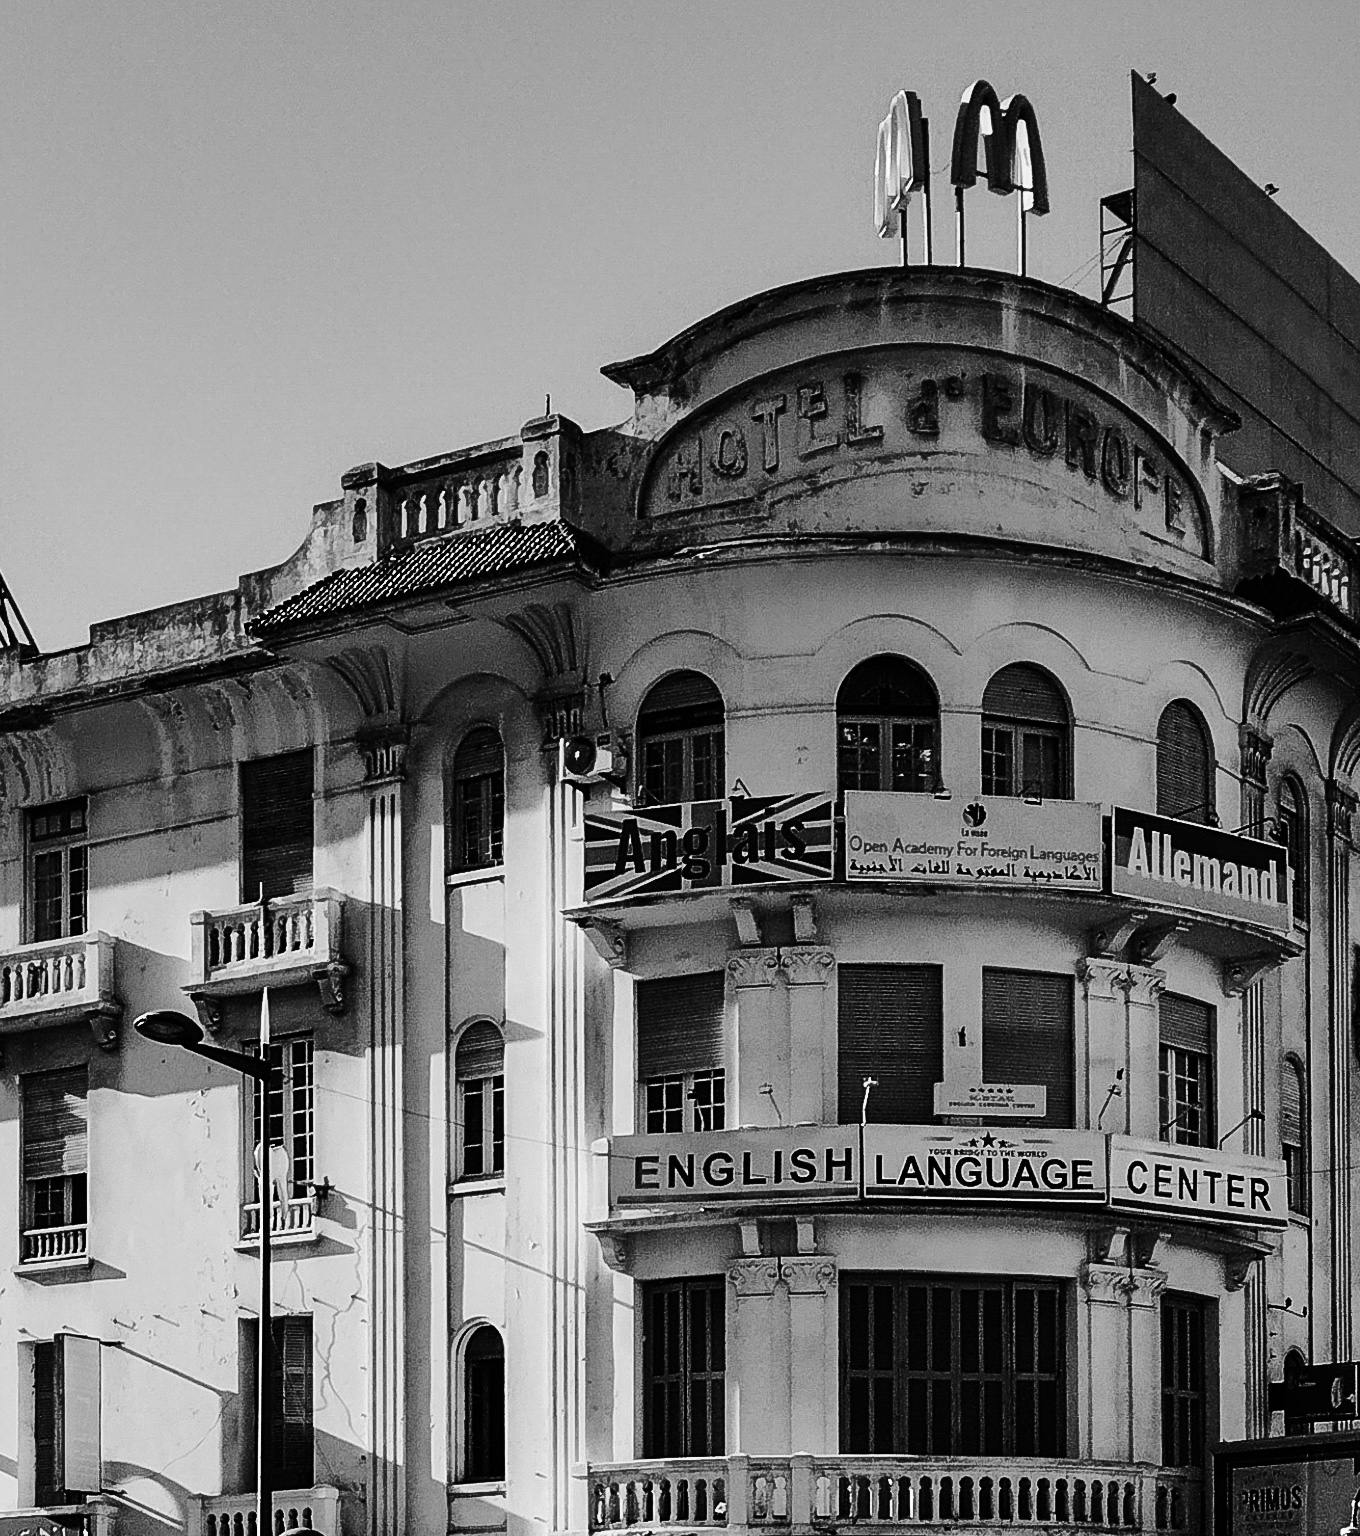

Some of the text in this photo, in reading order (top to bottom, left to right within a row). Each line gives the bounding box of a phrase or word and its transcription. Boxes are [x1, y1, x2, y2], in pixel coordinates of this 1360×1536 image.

[666, 368, 885, 499] HOTEL
[614, 806, 807, 881] Anglais
[849, 834, 1100, 865] Open Academy For Foreign Languages
[1127, 826, 1279, 907] Allemand
[634, 1147, 1272, 1212] ENGLISH LANGUAGE CENTER
[987, 1149, 998, 1157] TO
[1000, 1150, 1016, 1158] THE
